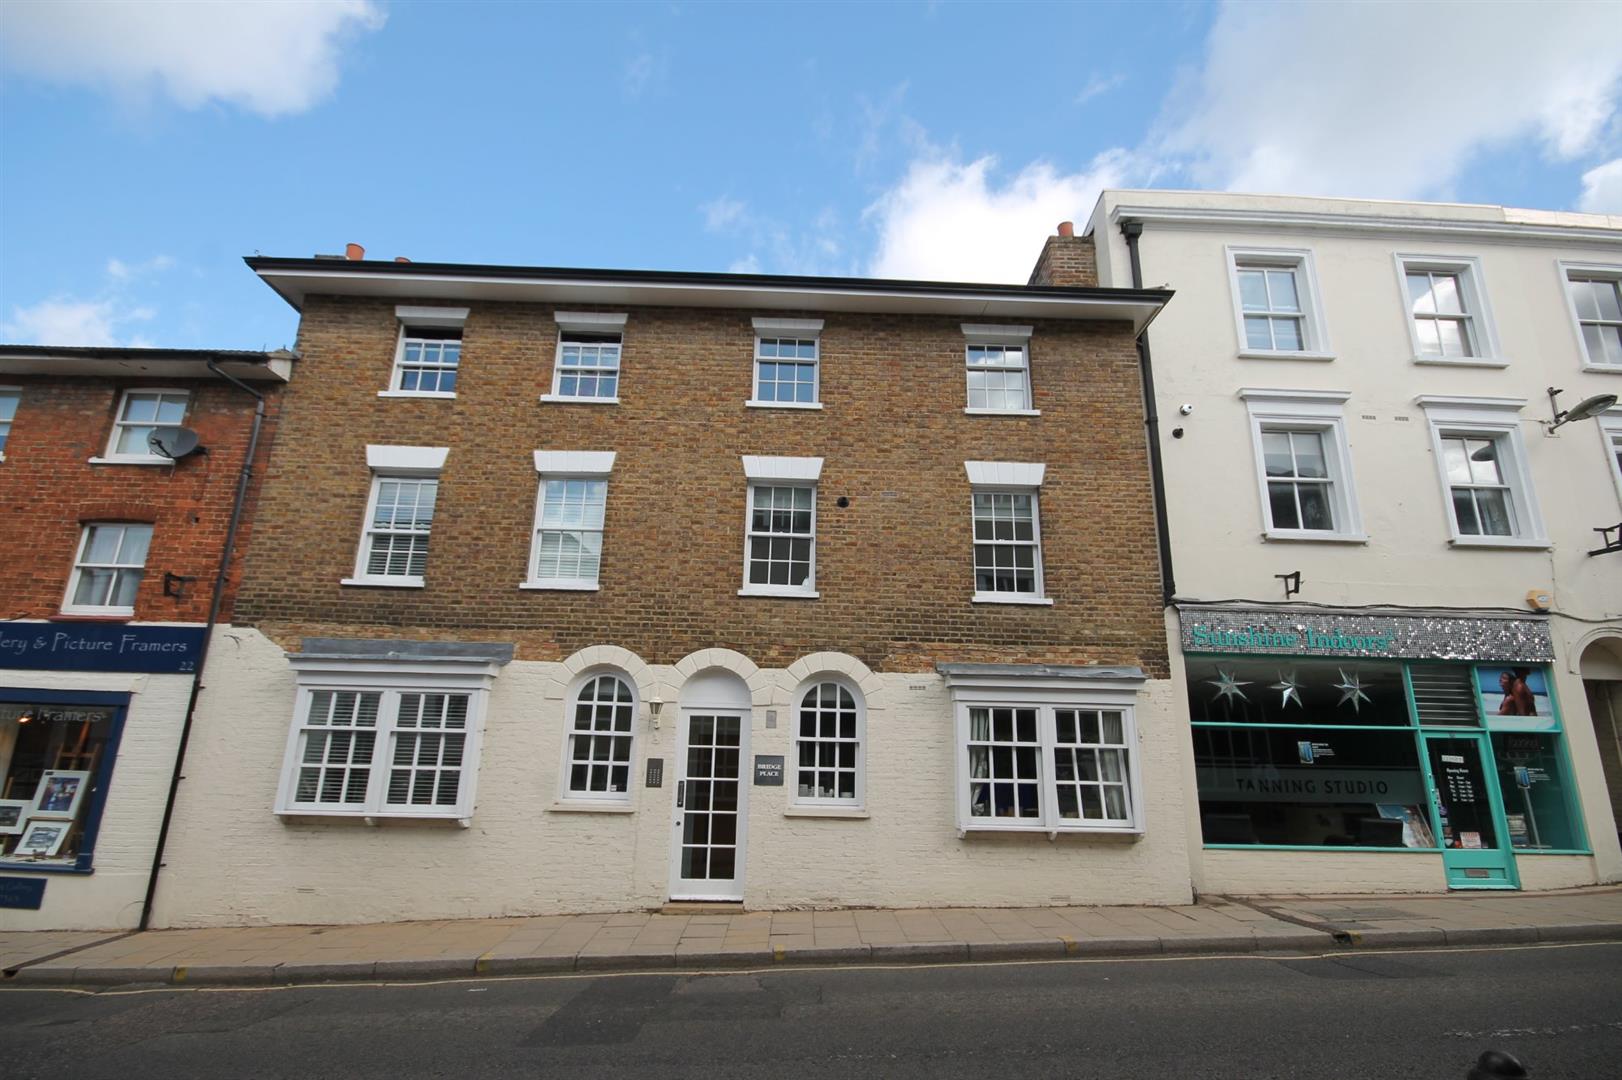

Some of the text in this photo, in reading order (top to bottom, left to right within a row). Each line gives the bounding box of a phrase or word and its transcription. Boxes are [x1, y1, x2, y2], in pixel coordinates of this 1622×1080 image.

[33, 636, 47, 649] &
[52, 631, 113, 652] Picture
[119, 634, 187, 654] Framers
[1192, 624, 1387, 650] Sunshine Indoors
[179, 661, 194, 671] 22
[37, 707, 103, 722] Framers
[1236, 778, 1388, 795] TANNING STUDIO
